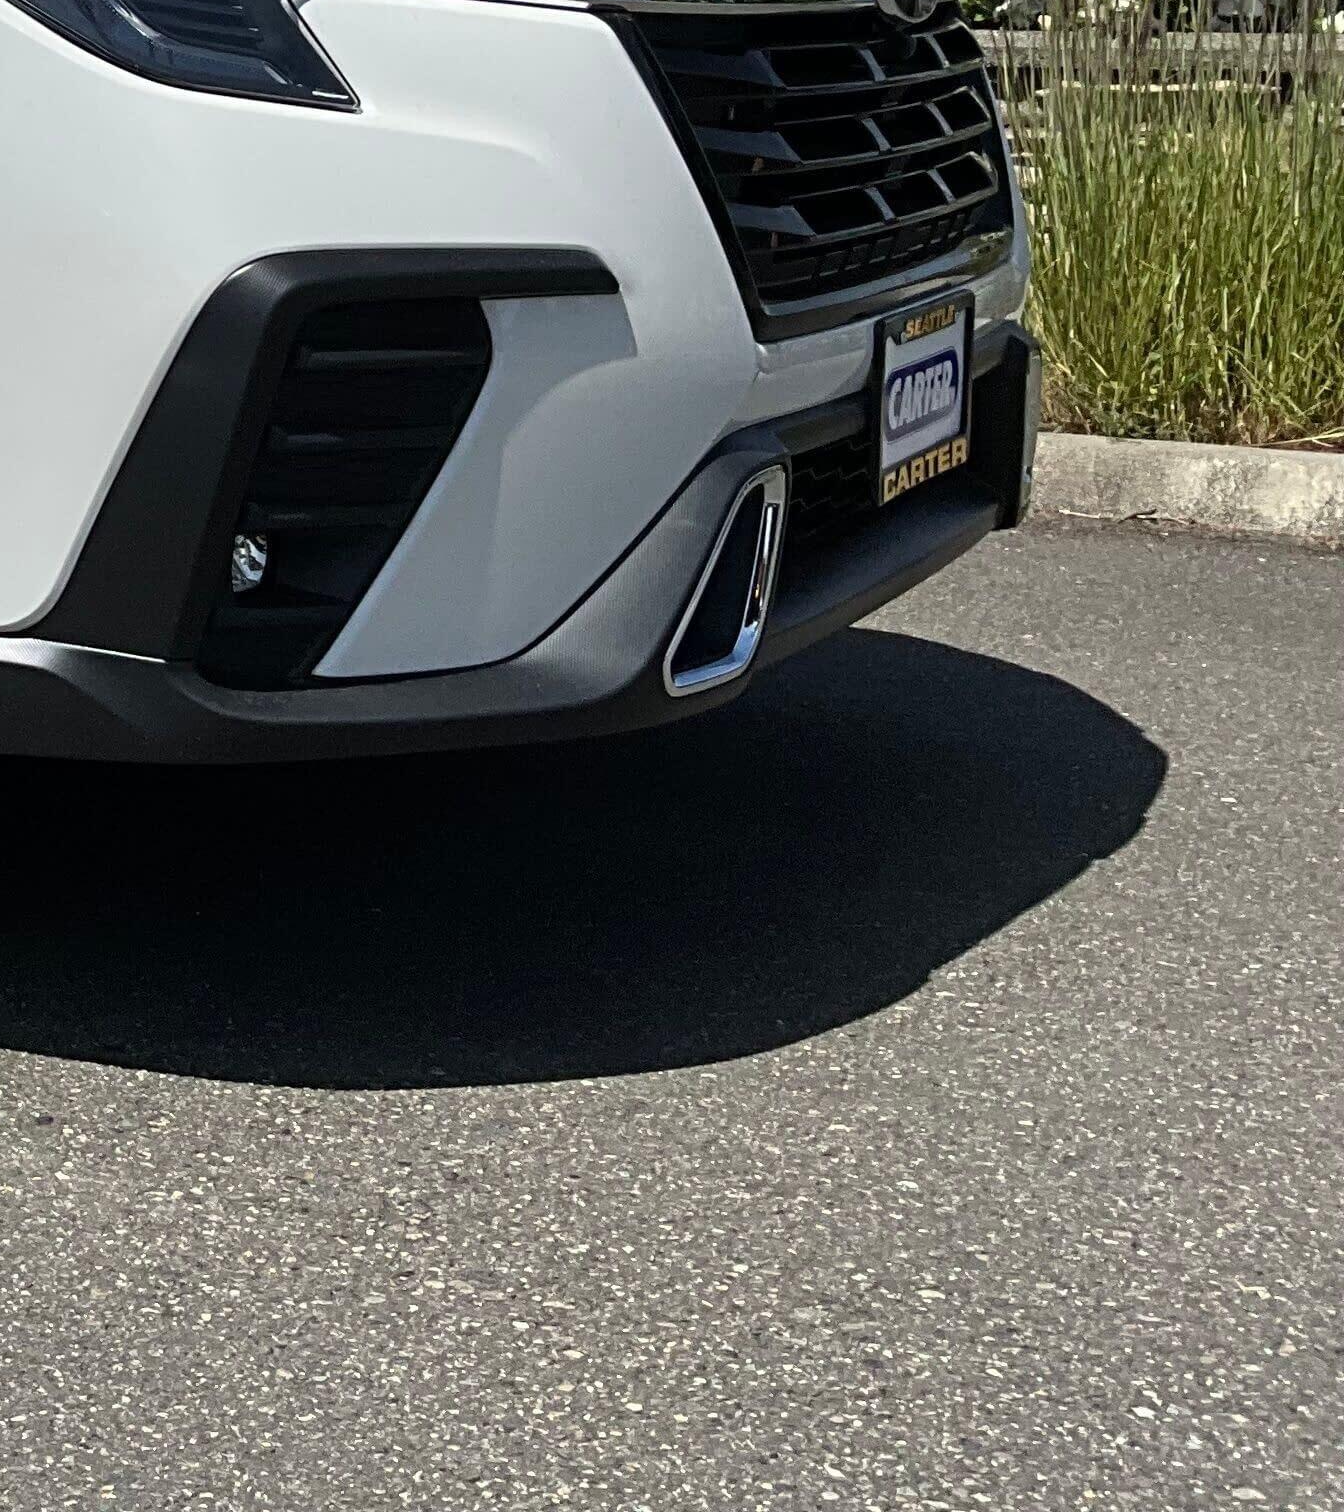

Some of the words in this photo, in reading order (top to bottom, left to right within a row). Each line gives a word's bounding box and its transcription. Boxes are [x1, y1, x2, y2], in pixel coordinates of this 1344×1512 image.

[904, 304, 956, 339] SEATTLE
[888, 360, 954, 430] CARTER
[883, 437, 968, 504] CARTER
